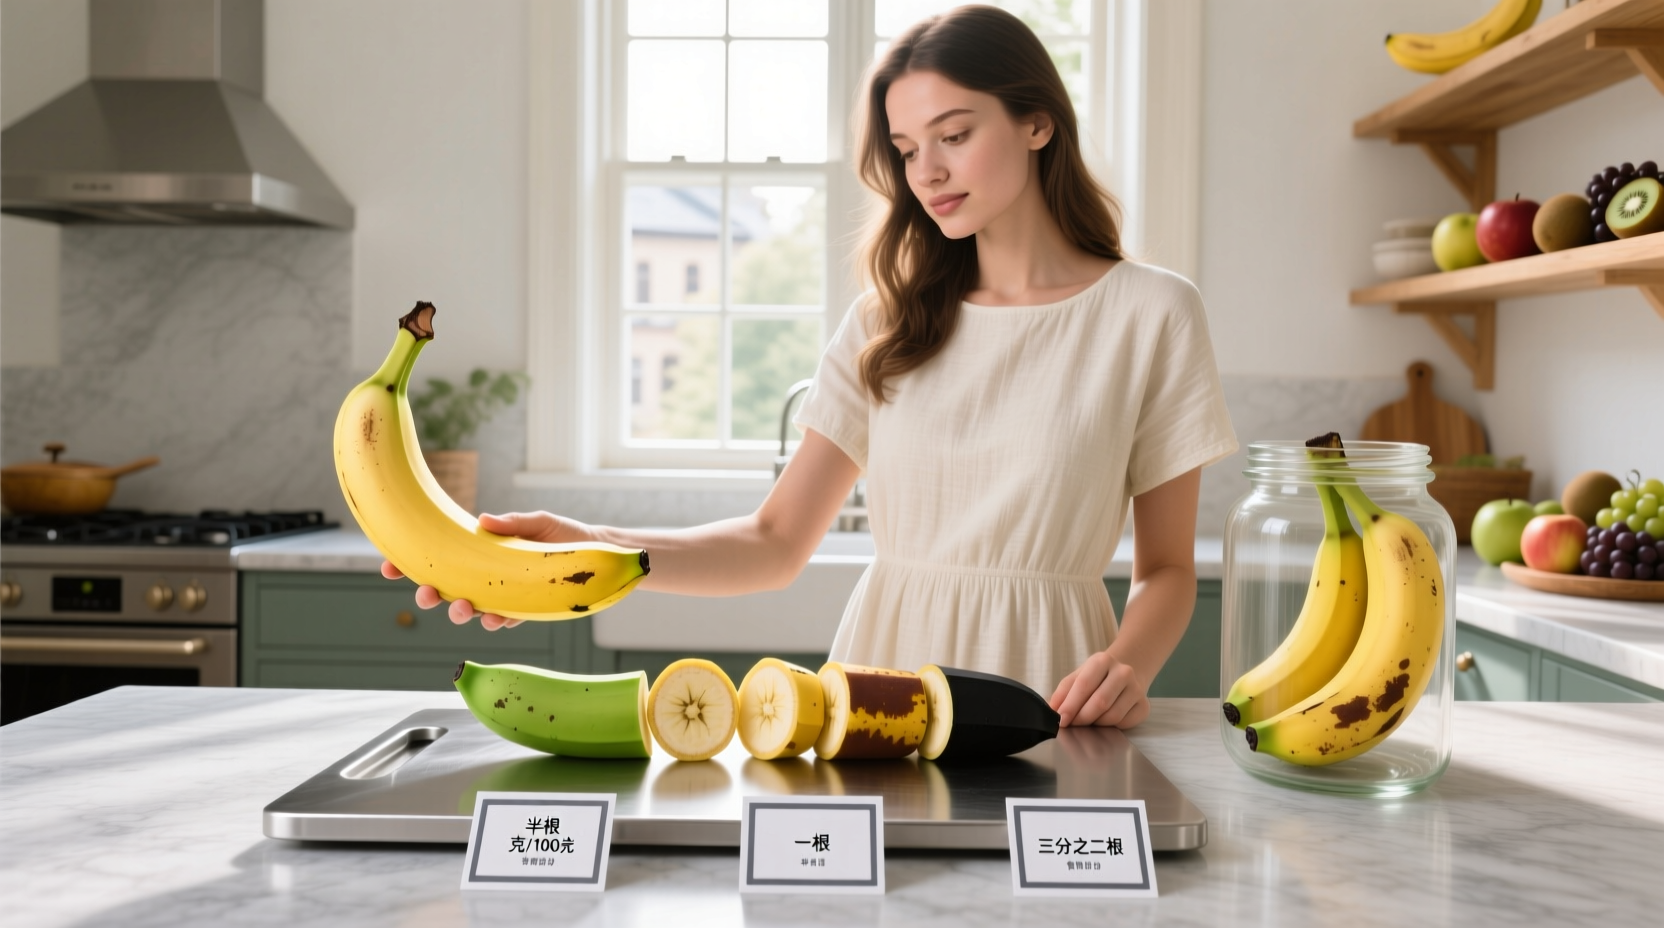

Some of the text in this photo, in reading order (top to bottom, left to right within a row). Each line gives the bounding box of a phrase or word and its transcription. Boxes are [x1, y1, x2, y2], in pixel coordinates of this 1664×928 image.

[525, 815, 560, 835] 半根
[795, 833, 830, 852] 一根
[1038, 837, 1124, 856] 三分之二根
